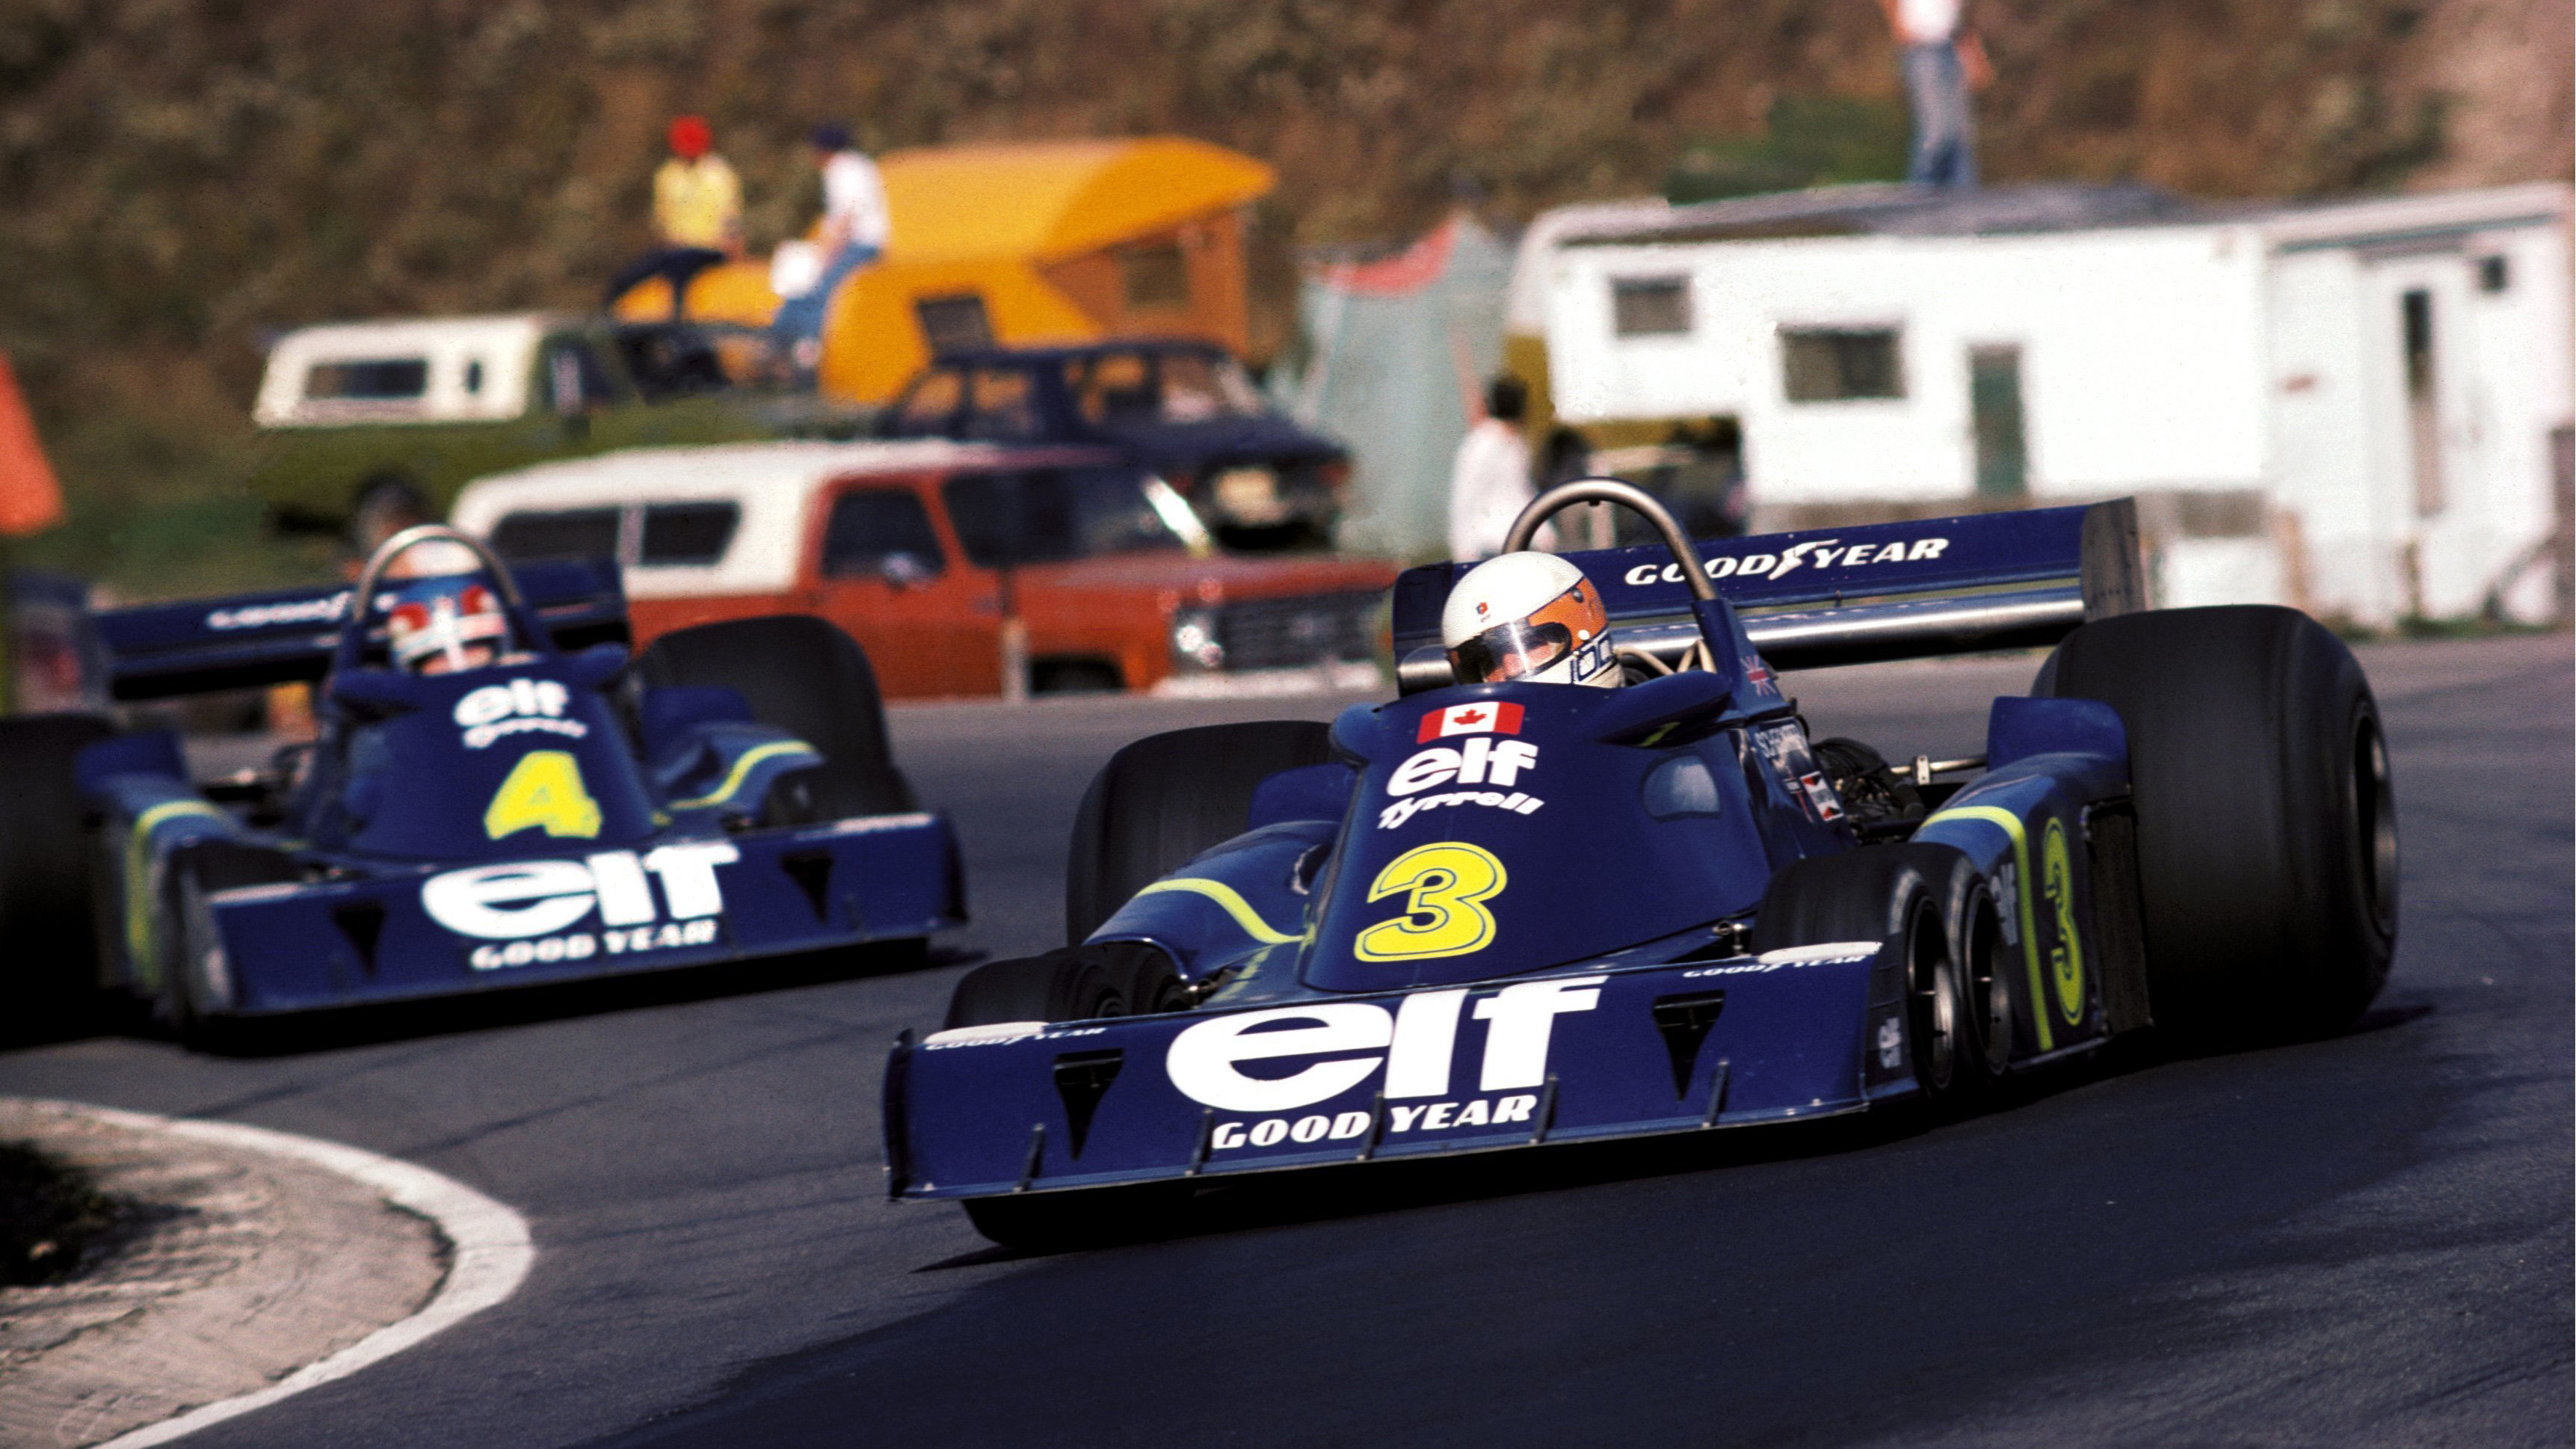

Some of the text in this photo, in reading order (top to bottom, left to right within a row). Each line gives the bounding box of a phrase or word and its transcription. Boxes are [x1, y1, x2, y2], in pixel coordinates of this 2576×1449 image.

[483, 749, 604, 840] 4
[1377, 791, 1545, 830] Tyrrell
[1386, 737, 1538, 797] elf
[422, 843, 740, 939] elf
[1353, 841, 1508, 962] 3
[2044, 816, 2084, 1026] 3
[470, 934, 597, 970] GOOD
[1166, 975, 1609, 1112] elf
[1212, 1095, 1538, 1150] GOOD YEAR
